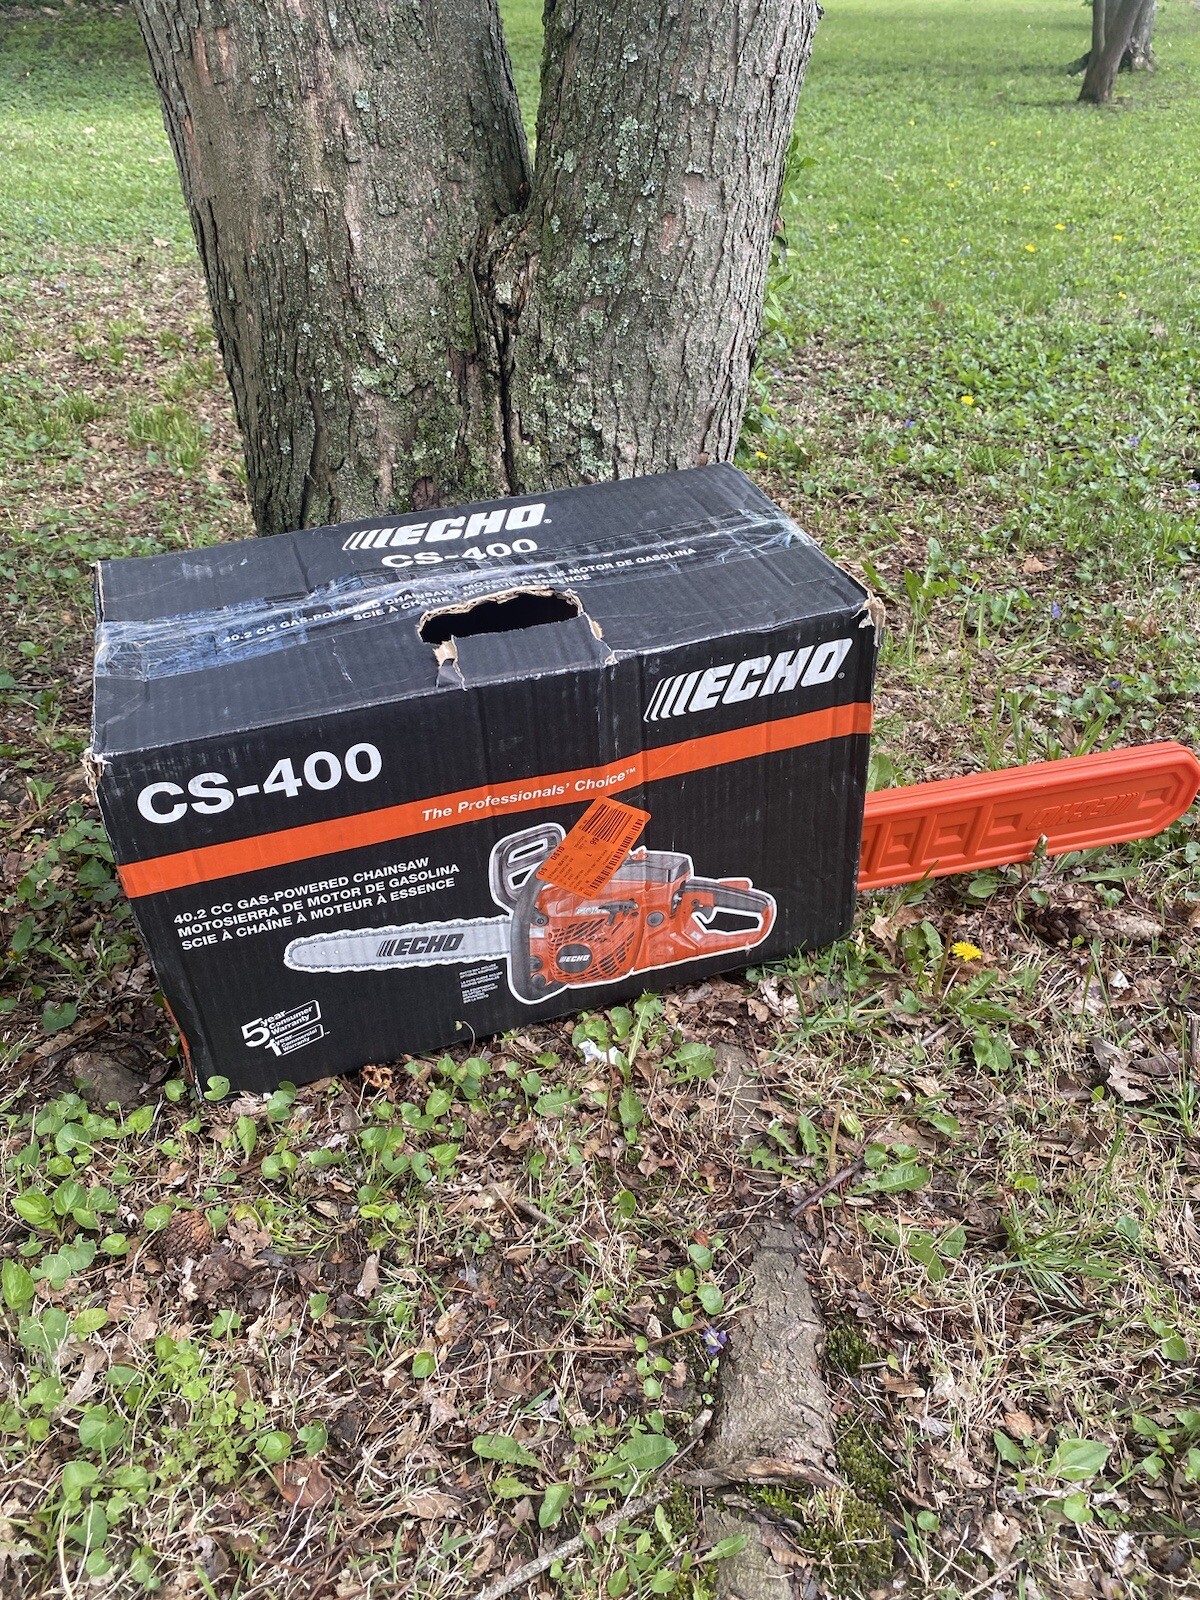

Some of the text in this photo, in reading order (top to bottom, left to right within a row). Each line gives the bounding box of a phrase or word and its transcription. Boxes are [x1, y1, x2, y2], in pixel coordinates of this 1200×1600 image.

[381, 538, 538, 568] CS-400
[256, 625, 276, 634] CC
[567, 562, 614, 576] MOTOR
[615, 559, 635, 568] DE
[635, 547, 697, 564] GASOLINA
[353, 609, 386, 621] SCIE
[137, 743, 383, 824] CS-400
[422, 808, 452, 822] The
[173, 856, 430, 925] 40.2 CC GAS-POWERED CHAINSAW
[177, 863, 460, 939] MOTOSIERRA DE MOTOR DE GASOLINA
[181, 877, 456, 951] SCIE À CHAÎNE À MOTEUR À ESSENCE
[394, 934, 465, 957] ECHO
[241, 1010, 286, 1048] 5 year
[268, 1006, 313, 1030] Consumer
[270, 1014, 310, 1035] Warranty
